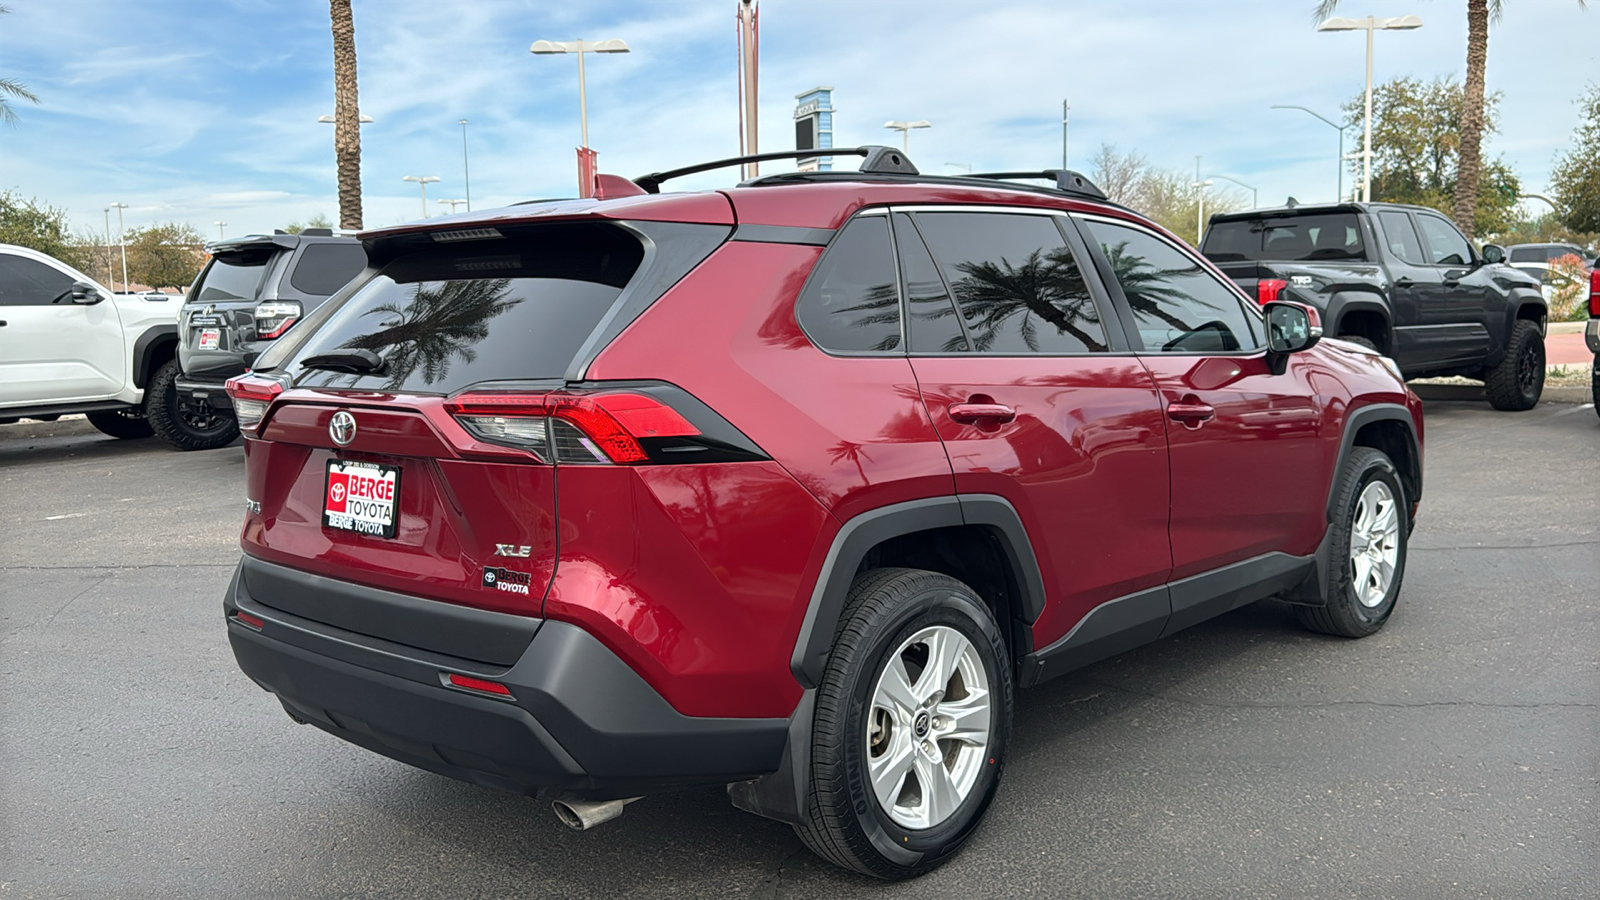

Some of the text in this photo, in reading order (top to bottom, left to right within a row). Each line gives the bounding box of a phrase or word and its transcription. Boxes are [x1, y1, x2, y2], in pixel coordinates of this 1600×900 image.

[349, 475, 393, 500] BERGE
[348, 500, 392, 520] TOYOTA
[328, 514, 384, 535] BERGE TOYOTA
[493, 543, 532, 558] XLE
[498, 568, 531, 584] BERGE
[497, 581, 529, 595] TOYOTA
